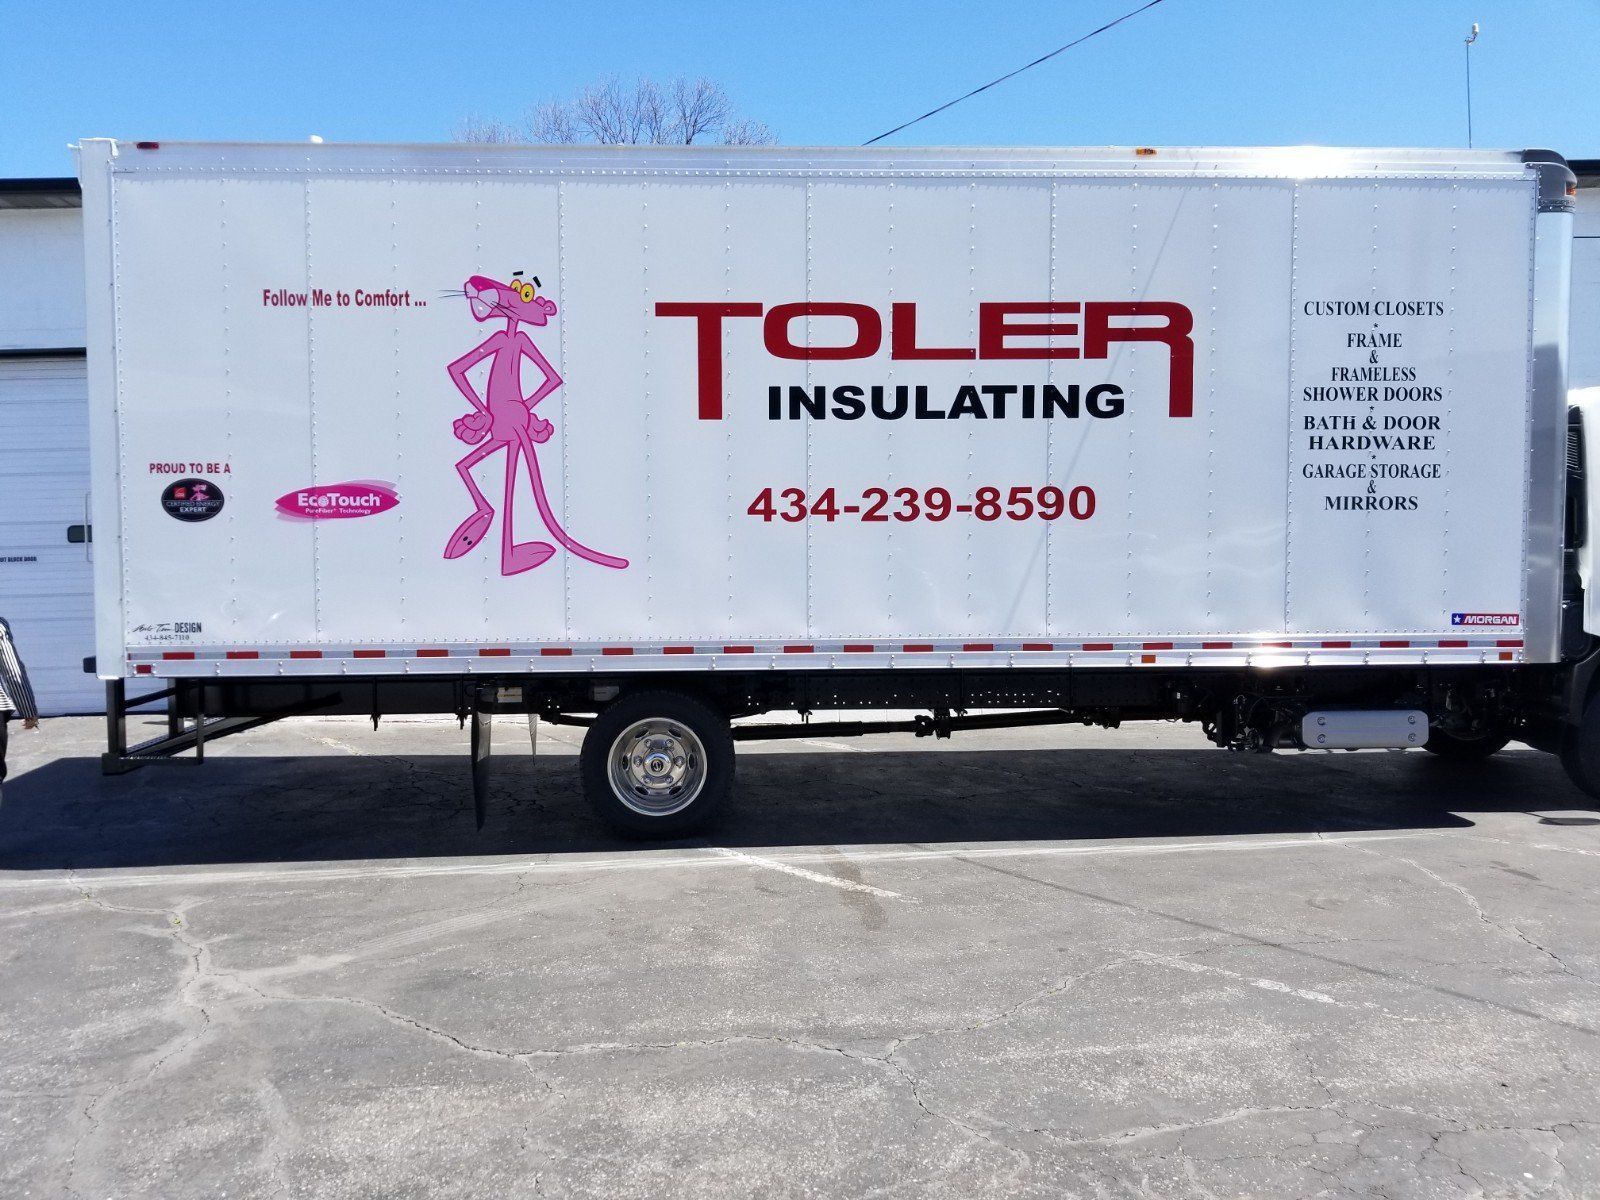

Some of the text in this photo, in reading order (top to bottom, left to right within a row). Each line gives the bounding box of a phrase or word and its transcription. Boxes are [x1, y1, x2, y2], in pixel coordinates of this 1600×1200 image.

[262, 289, 308, 307] Follow
[312, 289, 332, 307] Me
[337, 290, 350, 307] to
[355, 289, 410, 307] Comfort
[1303, 301, 1444, 317] CUSTOM CLOSETS
[1347, 333, 1402, 348] FRAME
[655, 301, 1194, 420] TOLER
[1369, 349, 1379, 364] &
[1331, 367, 1416, 382] FRAMELESS
[1303, 387, 1443, 402] SHOWER DOORS
[768, 384, 1126, 421] INSULATING
[1303, 415, 1441, 430] BATH & DOOR
[1308, 436, 1436, 451] HARDWARE
[149, 463, 231, 474] PROUD TO BE A
[1302, 464, 1441, 479] GARAGE STORAGE
[1367, 479, 1377, 494] &
[747, 486, 1097, 522] 434-239-8590
[1325, 496, 1419, 511] MIRRORS
[174, 622, 202, 633] DESIGN
[1463, 615, 1517, 625] MORGAN
